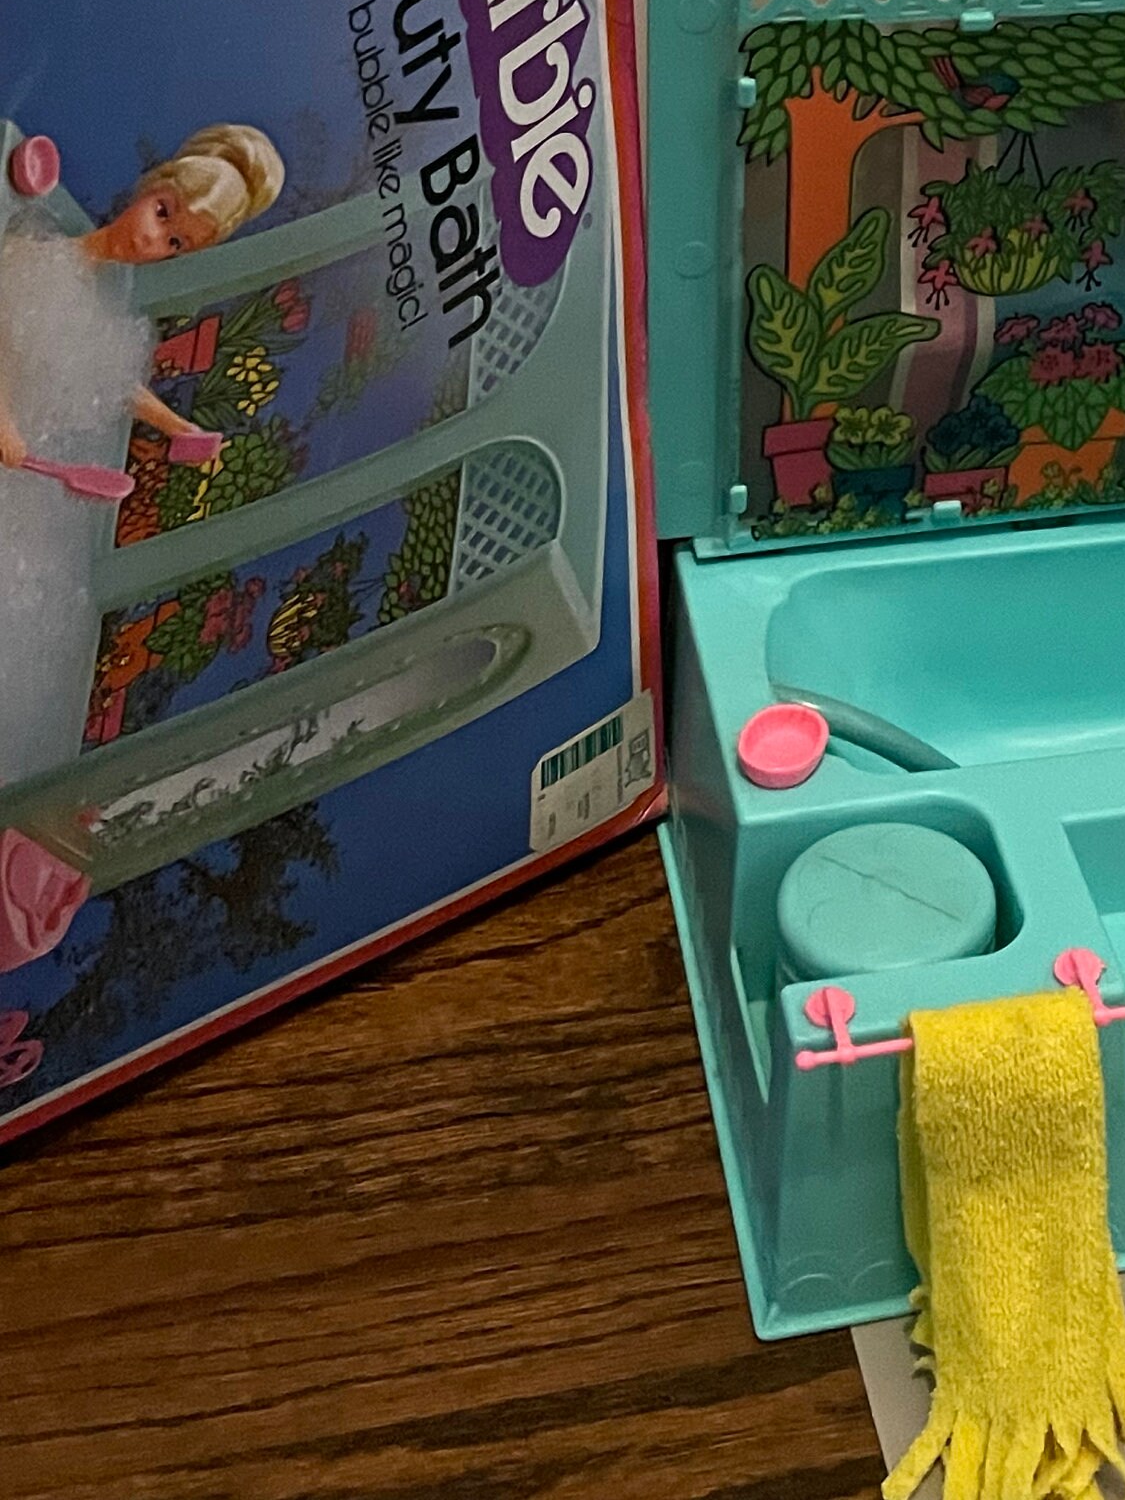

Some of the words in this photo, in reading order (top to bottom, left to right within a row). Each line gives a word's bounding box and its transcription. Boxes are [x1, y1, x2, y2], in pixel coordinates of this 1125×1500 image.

[374, 140, 401, 200] like
[382, 204, 428, 331] magic!
[420, 135, 502, 348] Bath
